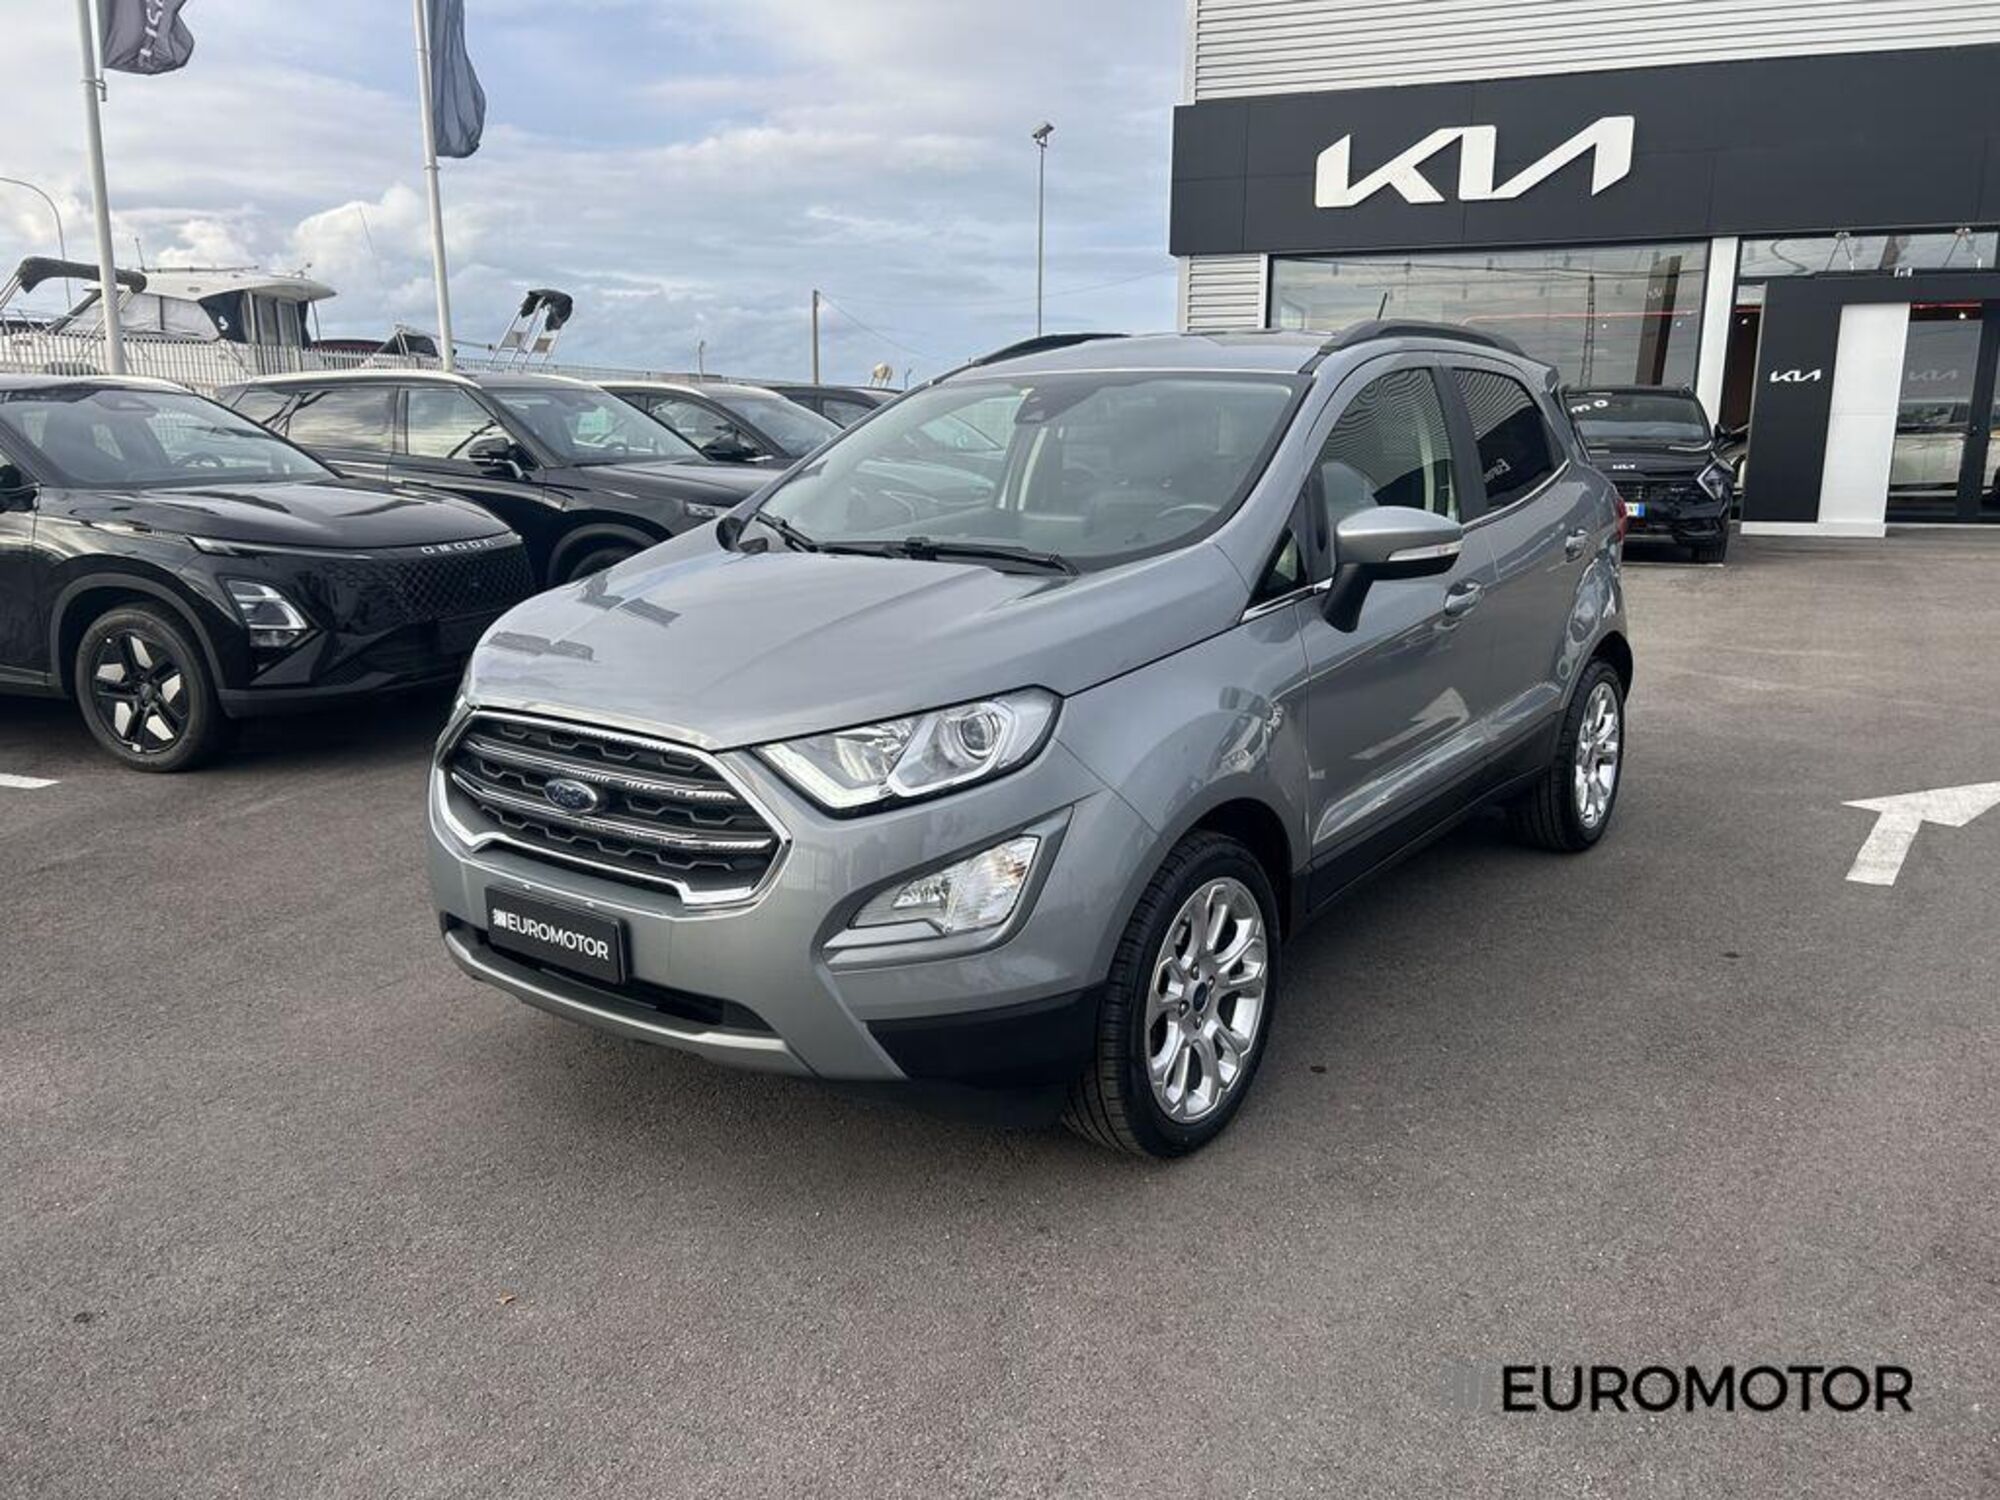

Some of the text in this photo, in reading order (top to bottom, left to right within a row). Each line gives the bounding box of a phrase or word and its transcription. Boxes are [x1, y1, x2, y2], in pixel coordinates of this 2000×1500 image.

[1315, 115, 1634, 208] KIA
[1769, 368, 1822, 383] KIA
[506, 912, 609, 960] EUROMOTOR
